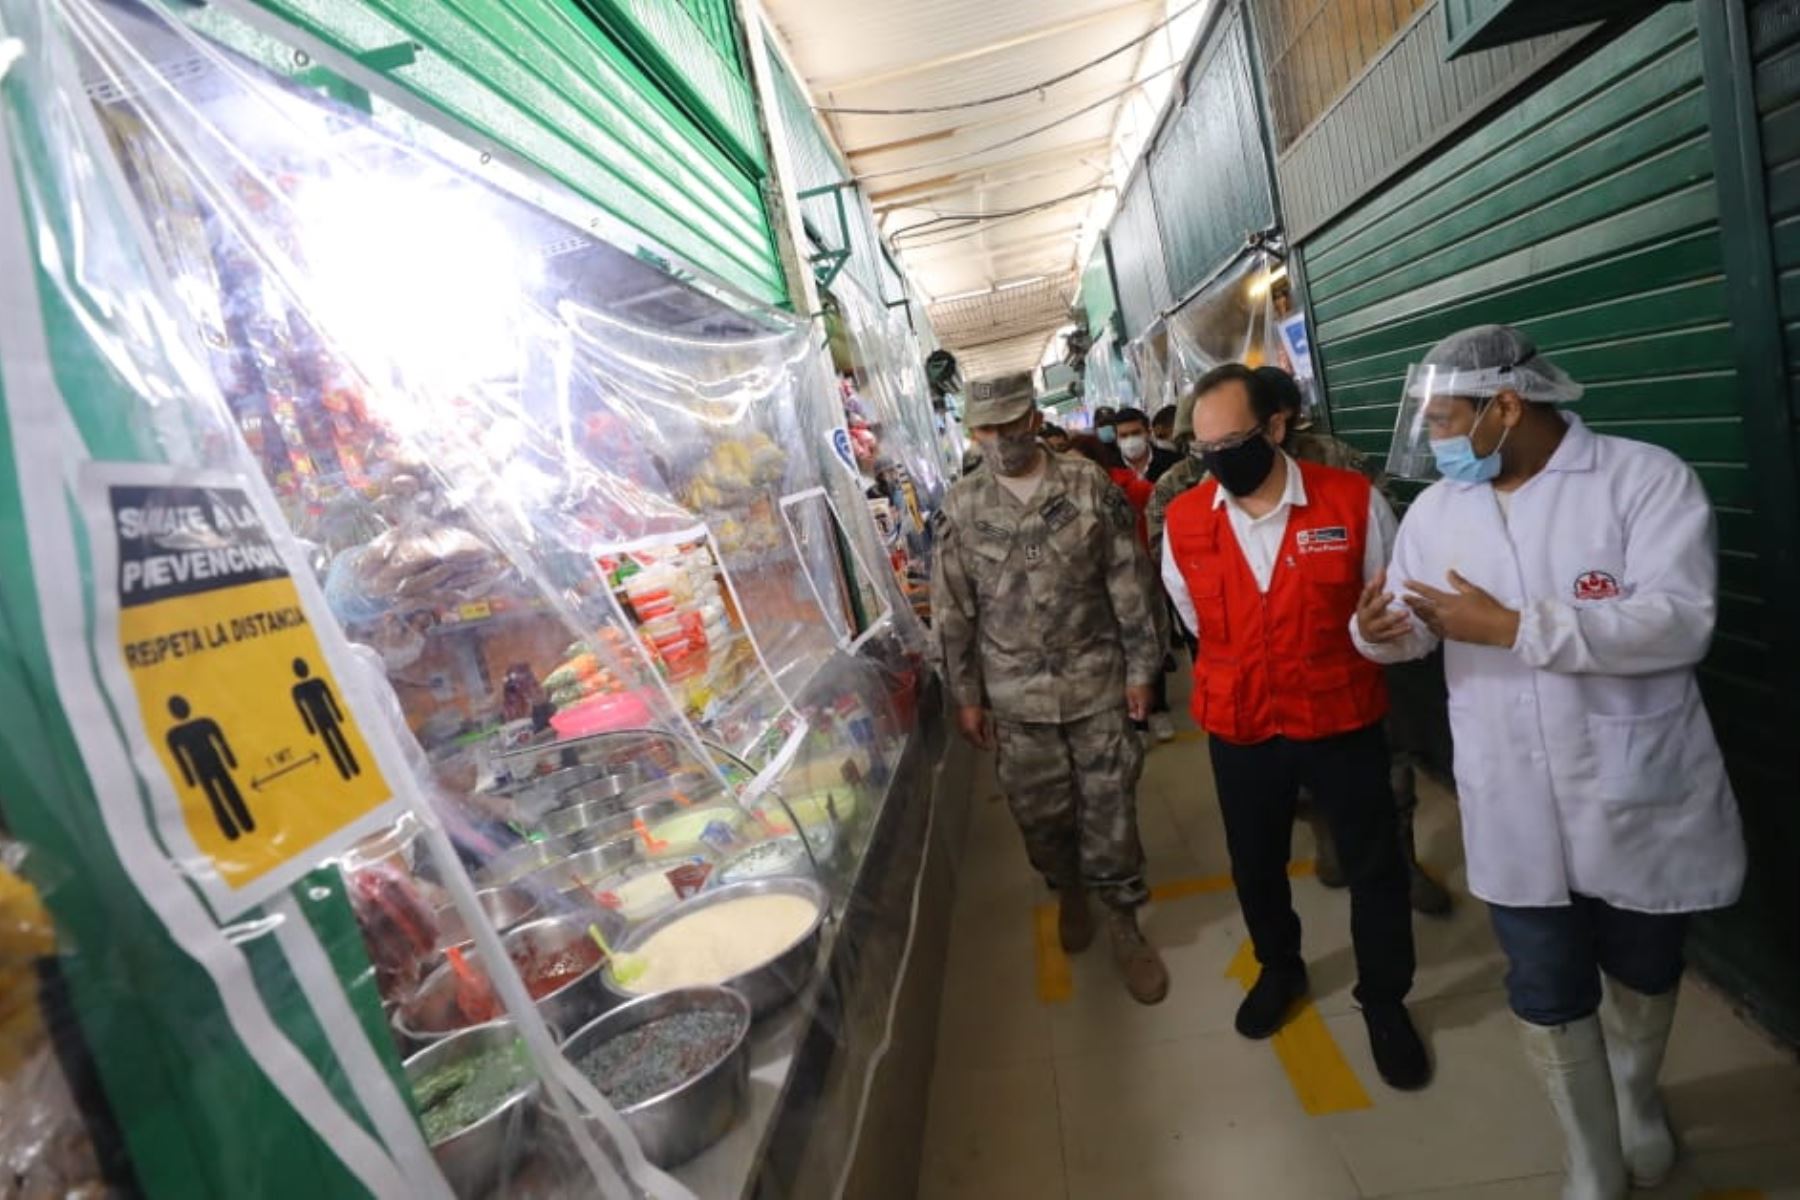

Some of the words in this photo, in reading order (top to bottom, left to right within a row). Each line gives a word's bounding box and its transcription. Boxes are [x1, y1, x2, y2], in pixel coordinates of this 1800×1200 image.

[124, 628, 204, 669] RESPETA
[204, 621, 230, 648] LA
[230, 606, 307, 643] DISTANCIA
